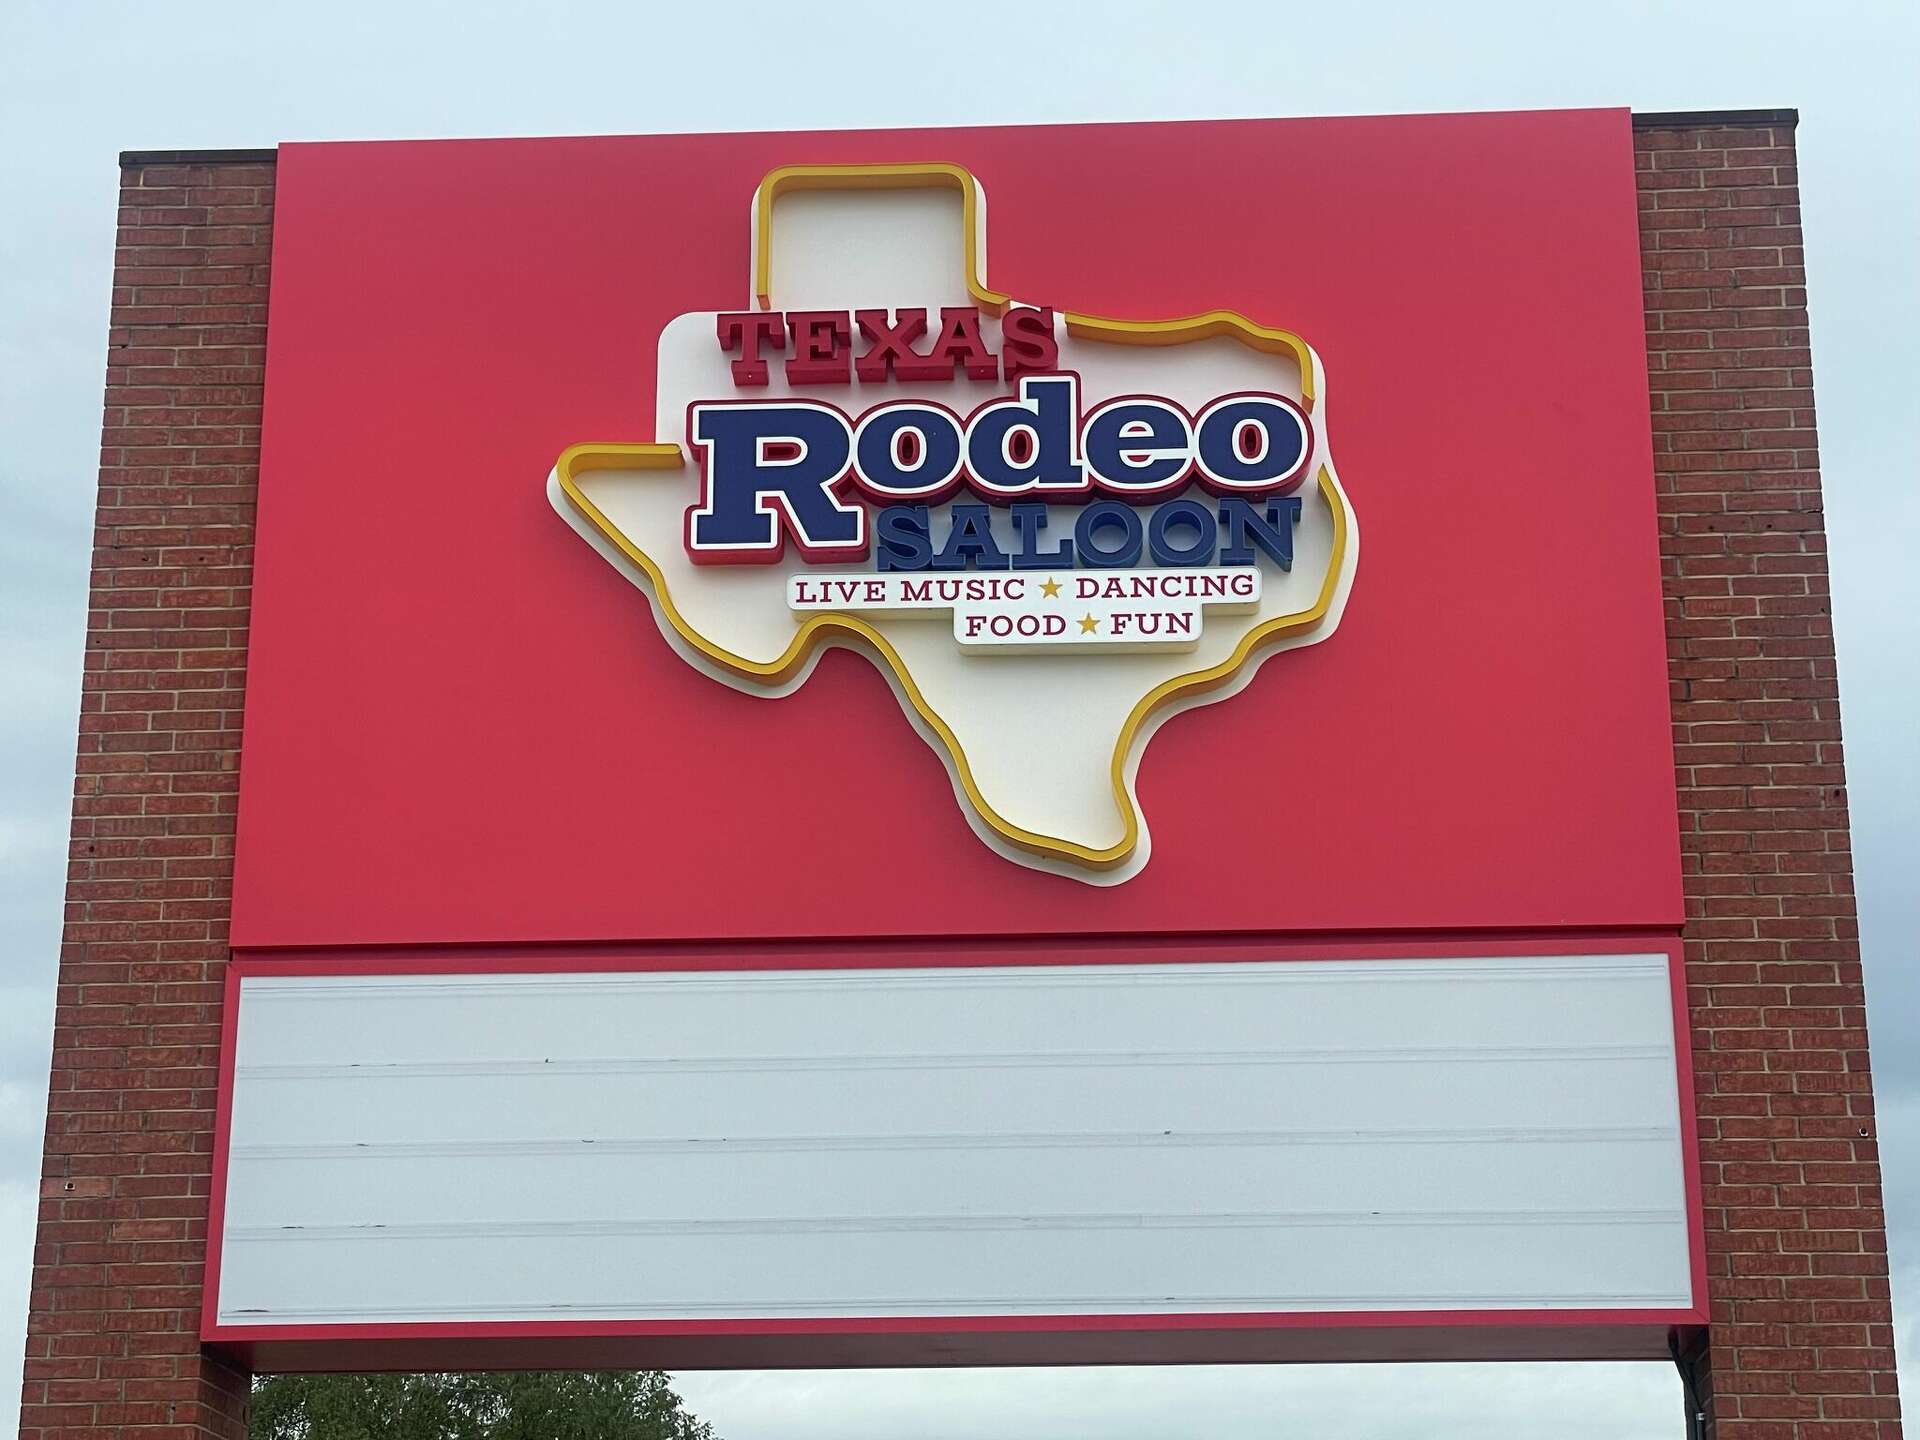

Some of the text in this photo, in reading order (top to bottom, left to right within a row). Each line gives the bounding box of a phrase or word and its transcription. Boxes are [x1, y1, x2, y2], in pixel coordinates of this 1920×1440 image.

[717, 306, 1058, 386] TEXAS
[688, 373, 1311, 558] Rodeo
[877, 498, 1302, 572] SALOON
[795, 574, 1254, 602] LIVE MUSIC DANCING
[965, 611, 1194, 639] FOOD FUN
